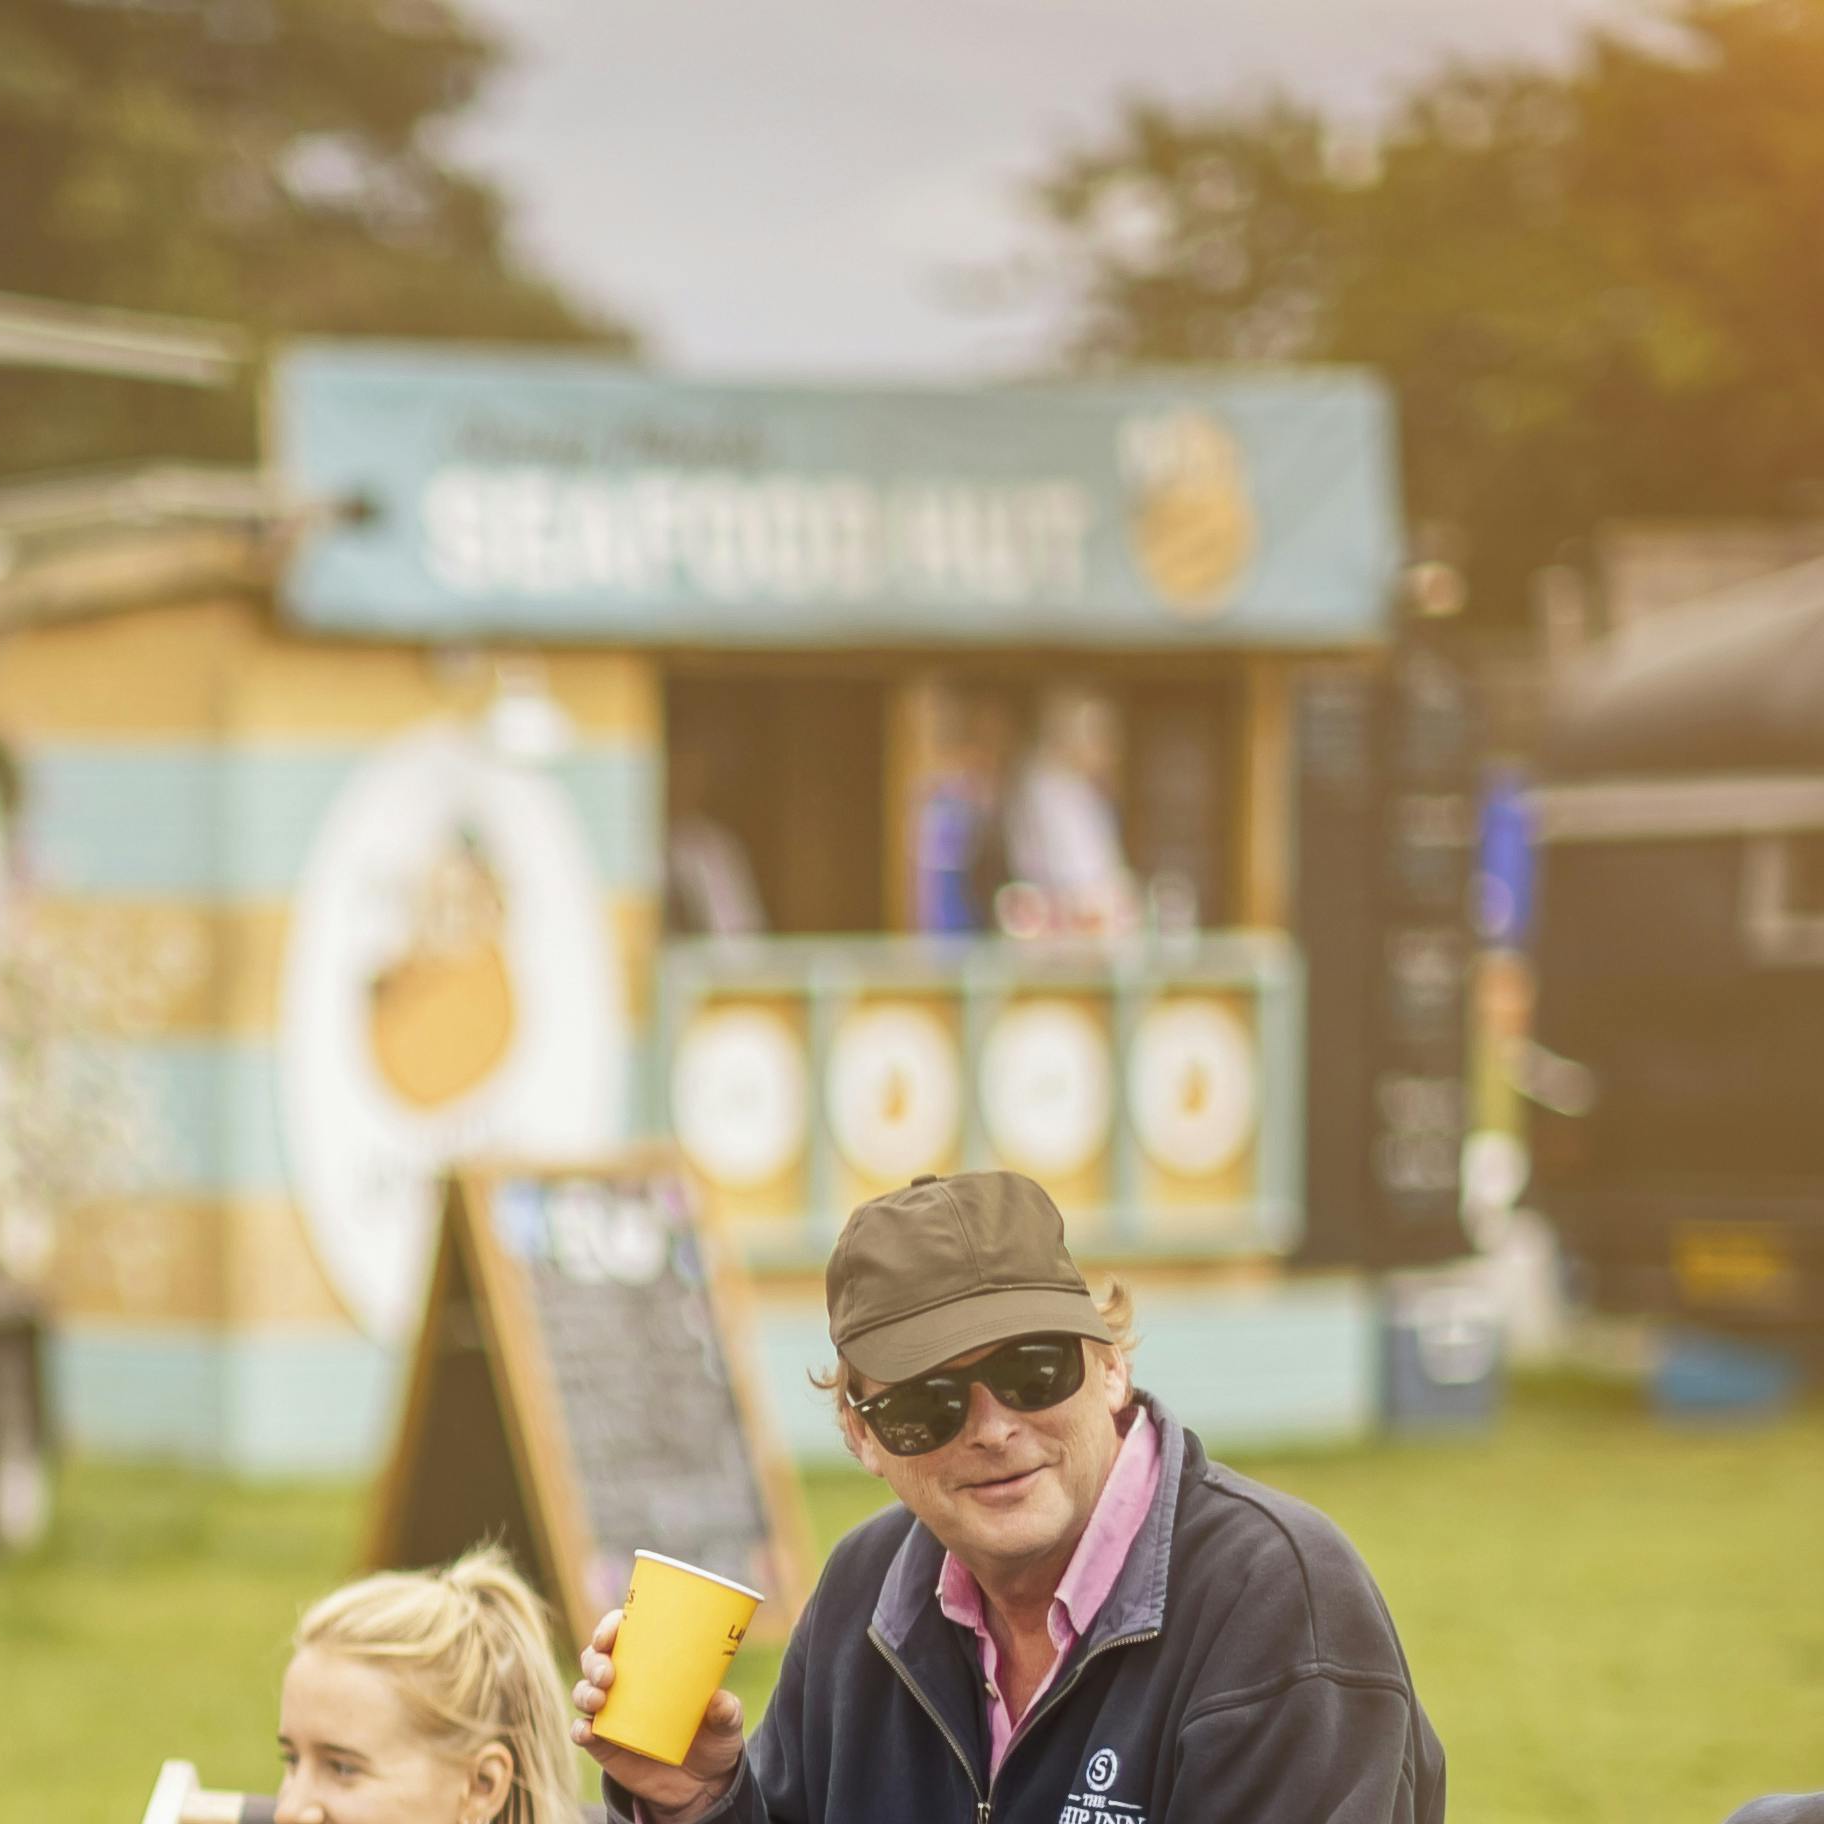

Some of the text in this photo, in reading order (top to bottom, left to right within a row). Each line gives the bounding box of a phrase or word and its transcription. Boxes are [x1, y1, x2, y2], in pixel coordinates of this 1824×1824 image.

[420, 470, 1094, 604] SEAFOOD HUT
[1082, 1793, 1106, 1809] THE
